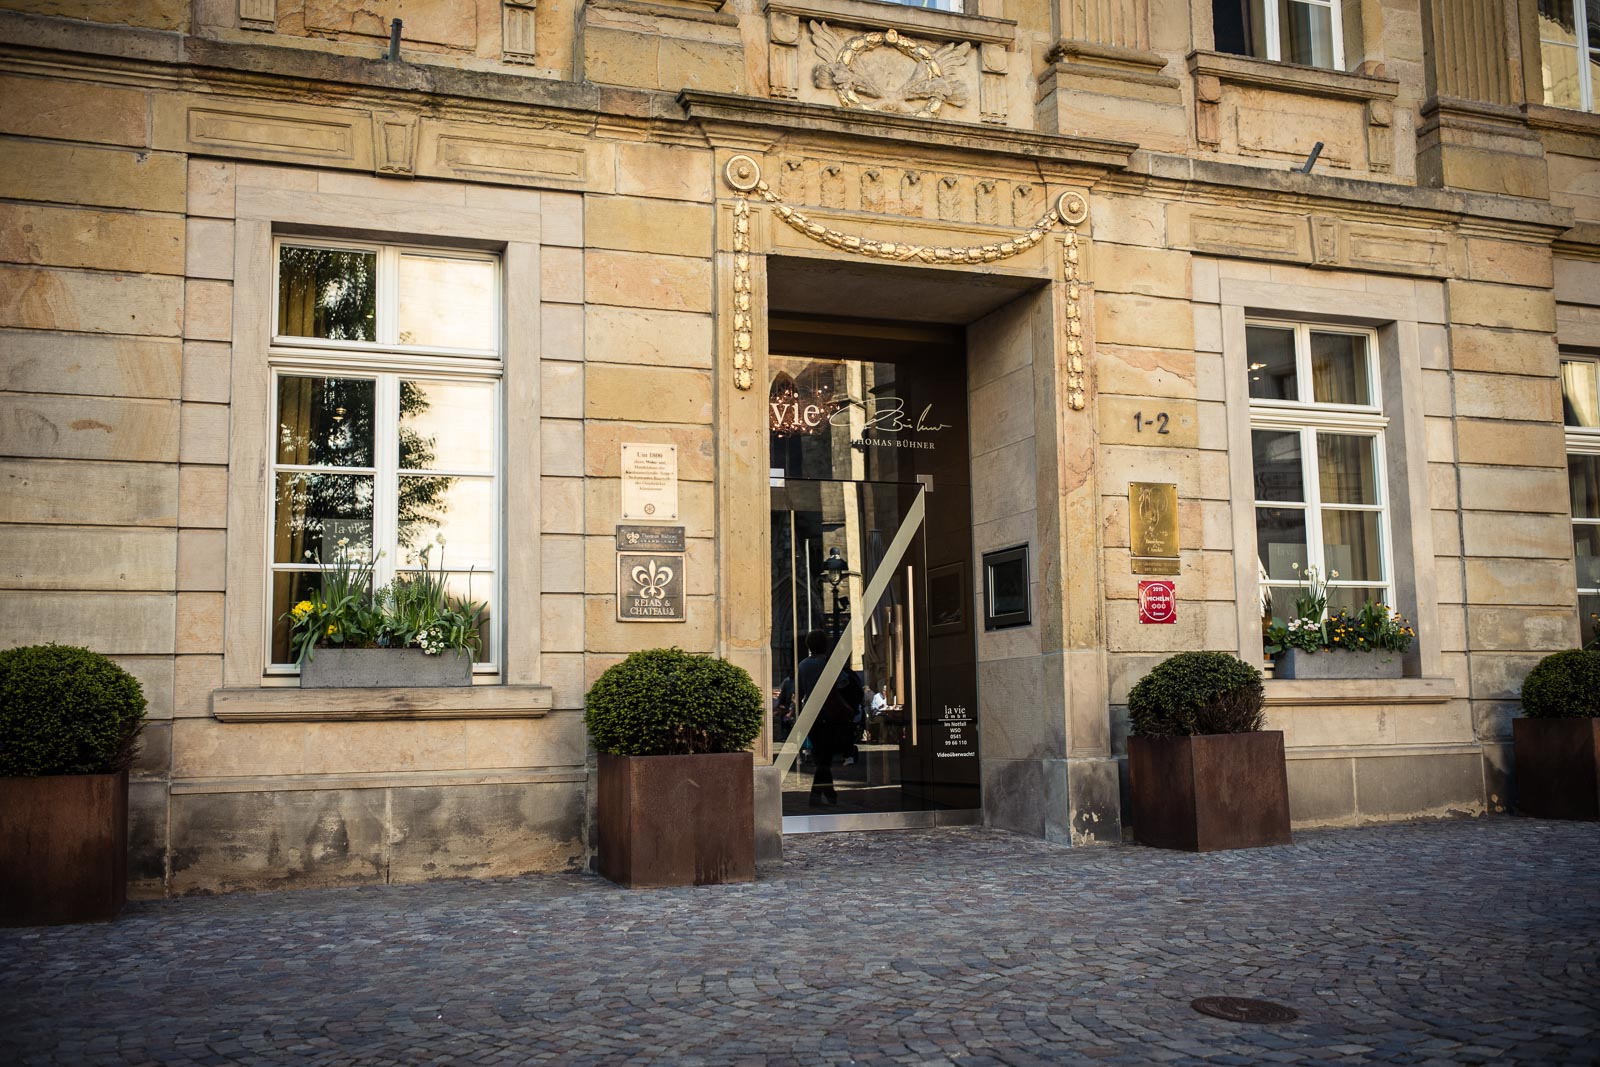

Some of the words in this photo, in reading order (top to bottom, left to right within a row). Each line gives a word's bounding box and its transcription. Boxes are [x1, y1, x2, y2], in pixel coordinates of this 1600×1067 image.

[769, 392, 820, 427] vie
[1133, 411, 1170, 434] 1-2
[852, 438, 892, 447] THOMAS
[896, 438, 935, 450] BÜHNER
[634, 599, 662, 607] RELAIS
[944, 705, 952, 714] la
[953, 705, 966, 714] vie
